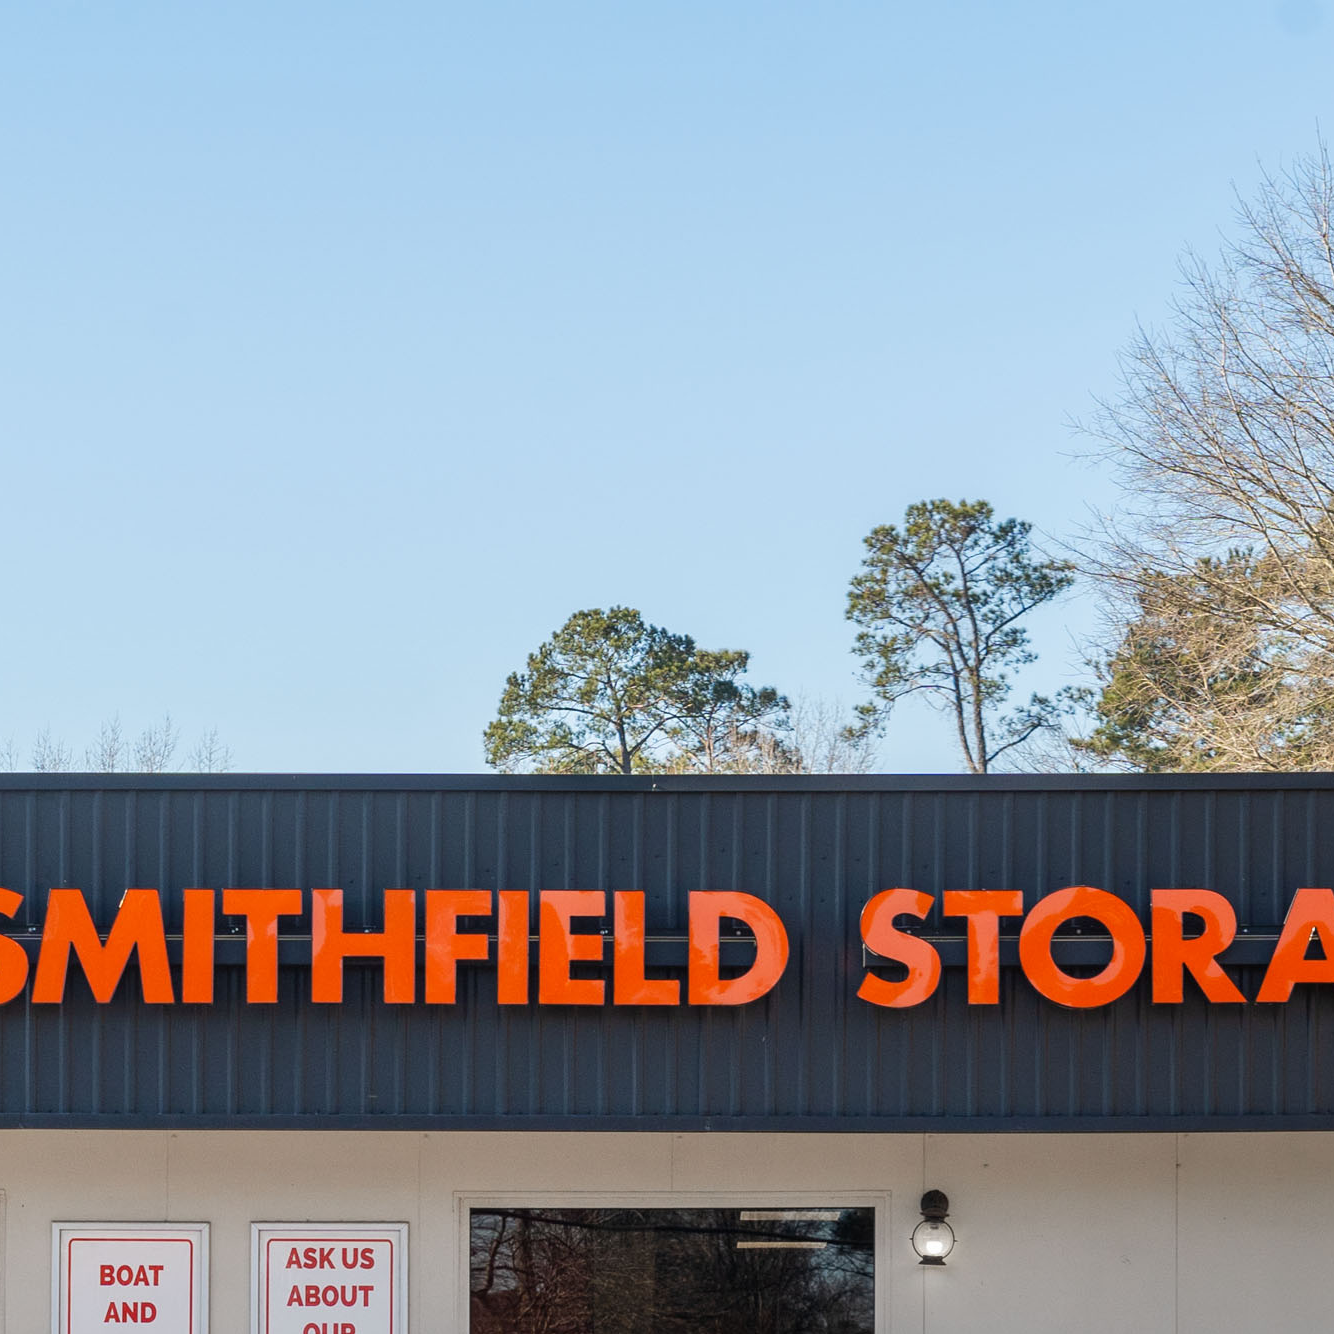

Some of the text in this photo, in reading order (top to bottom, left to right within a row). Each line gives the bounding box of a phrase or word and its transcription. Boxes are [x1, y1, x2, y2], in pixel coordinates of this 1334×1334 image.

[285, 1247, 375, 1270] ASK US
[99, 1264, 164, 1287] BOAT
[286, 1284, 375, 1308] ABOUT
[103, 1301, 158, 1324] AND
